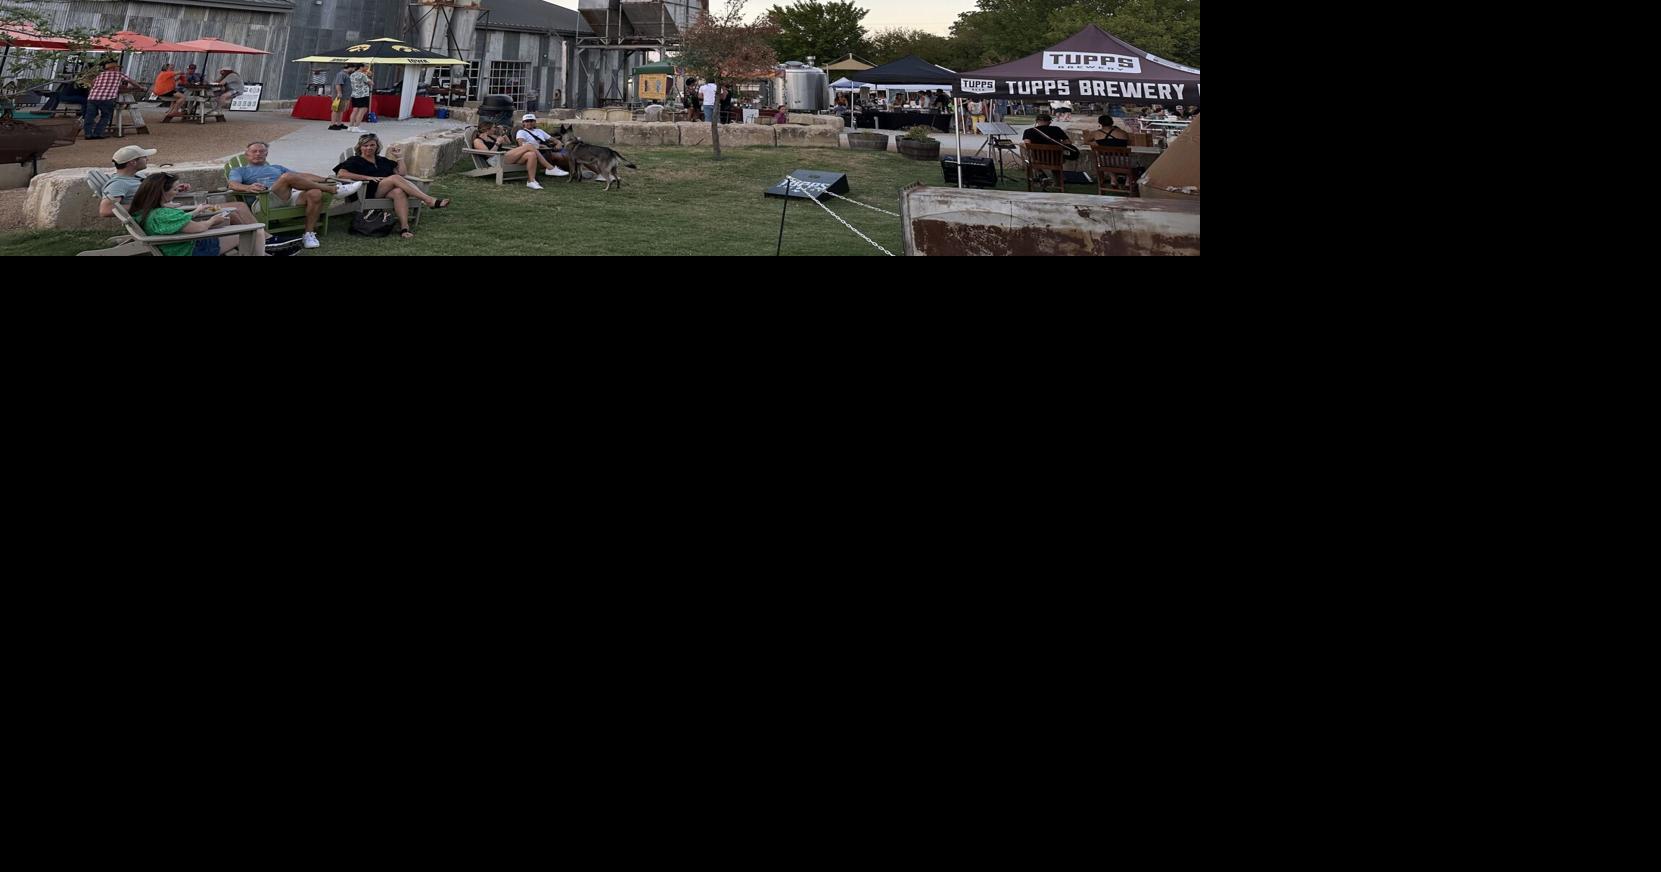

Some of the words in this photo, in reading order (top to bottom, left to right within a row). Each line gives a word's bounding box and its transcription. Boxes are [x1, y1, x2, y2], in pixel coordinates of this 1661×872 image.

[1049, 53, 1134, 69] TUPPS
[963, 80, 993, 89] TUPPS
[1005, 80, 1071, 96] TUPPS
[1078, 79, 1185, 100] BREWERY
